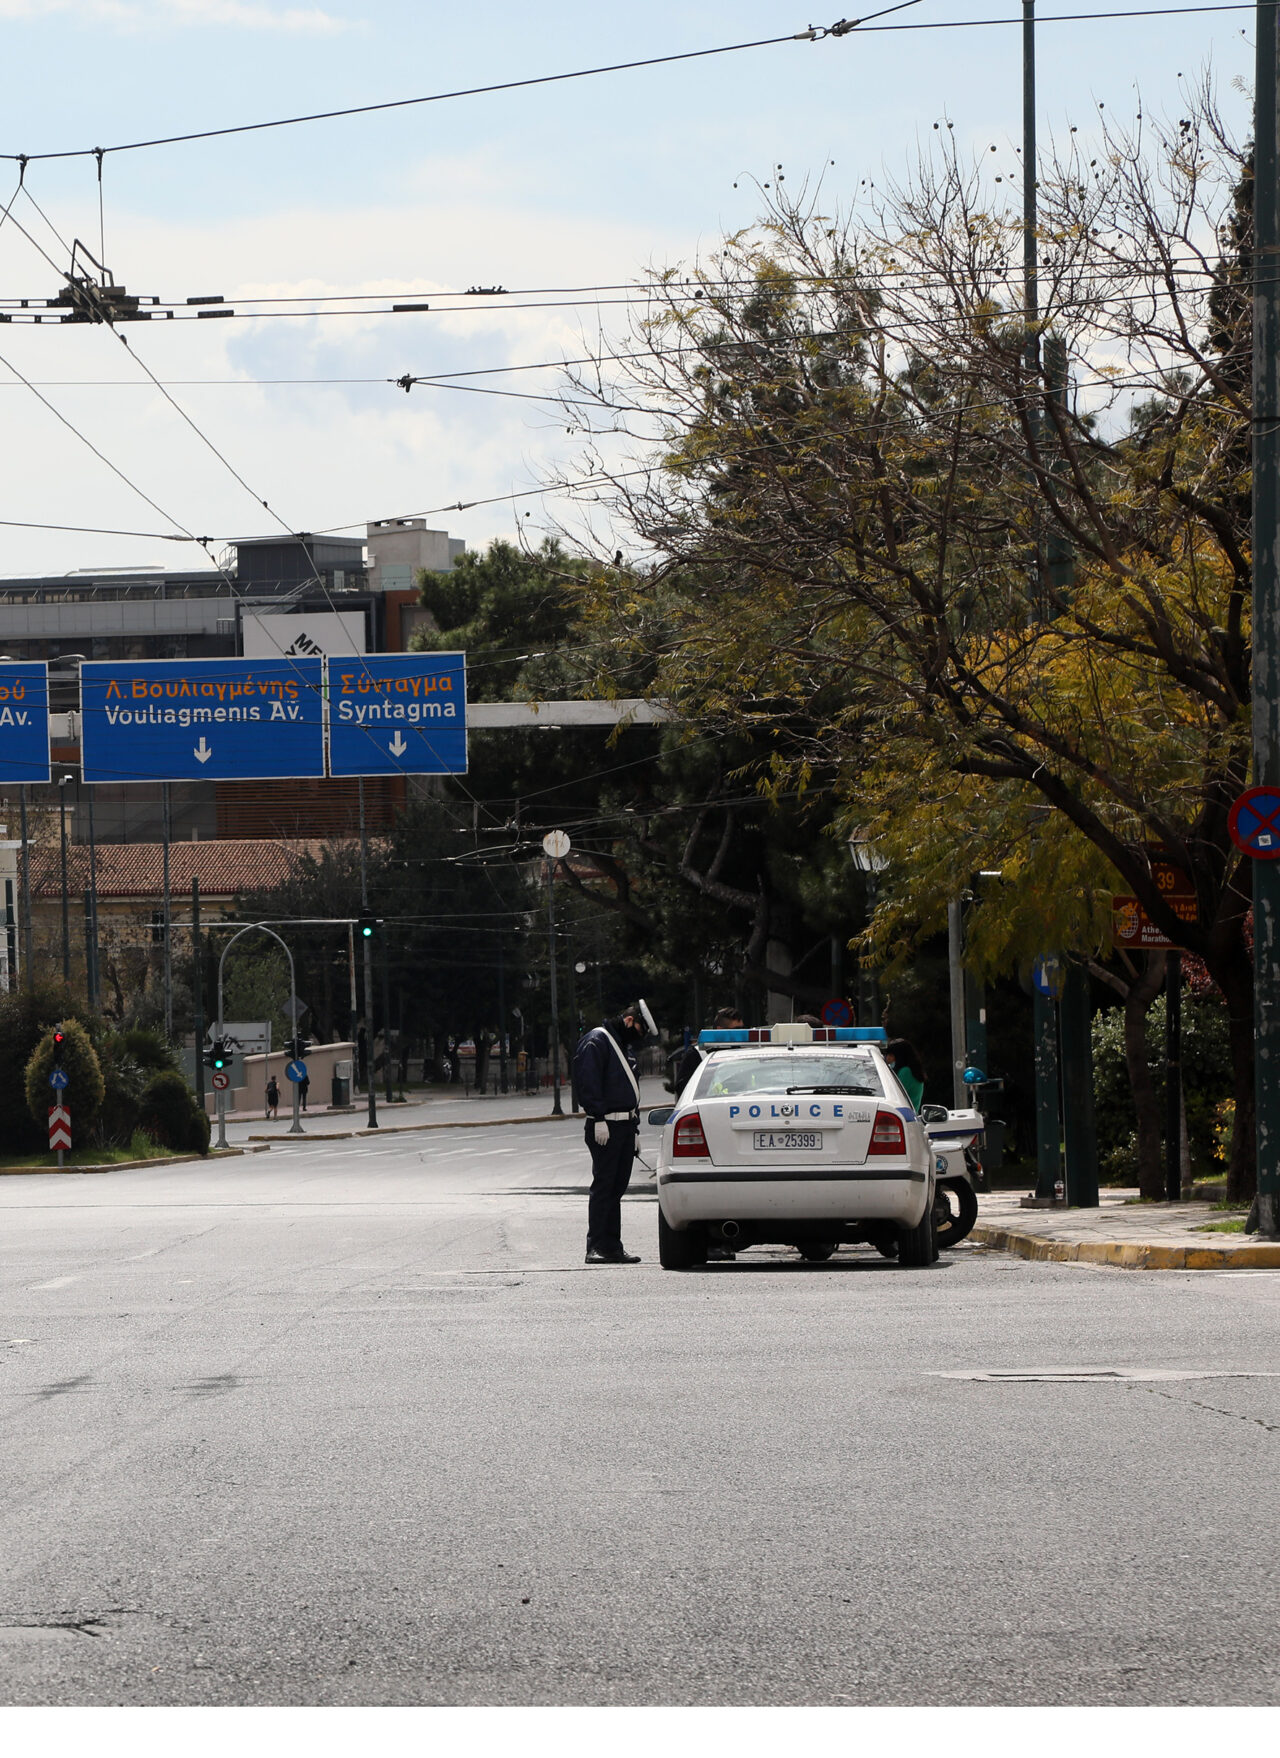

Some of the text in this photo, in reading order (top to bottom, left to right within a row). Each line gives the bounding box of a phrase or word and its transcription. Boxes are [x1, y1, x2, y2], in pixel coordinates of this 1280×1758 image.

[341, 673, 453, 697] Σύνταγμα
[0, 706, 33, 727] Av.
[104, 701, 305, 727] Vouliagmenis Av.
[338, 699, 457, 724] Syntagma
[1157, 872, 1176, 890] 39
[1141, 925, 1163, 935] Athe
[1141, 934, 1172, 944] Maratho
[729, 1104, 843, 1119] POLICE
[784, 1134, 816, 1148] 25399
